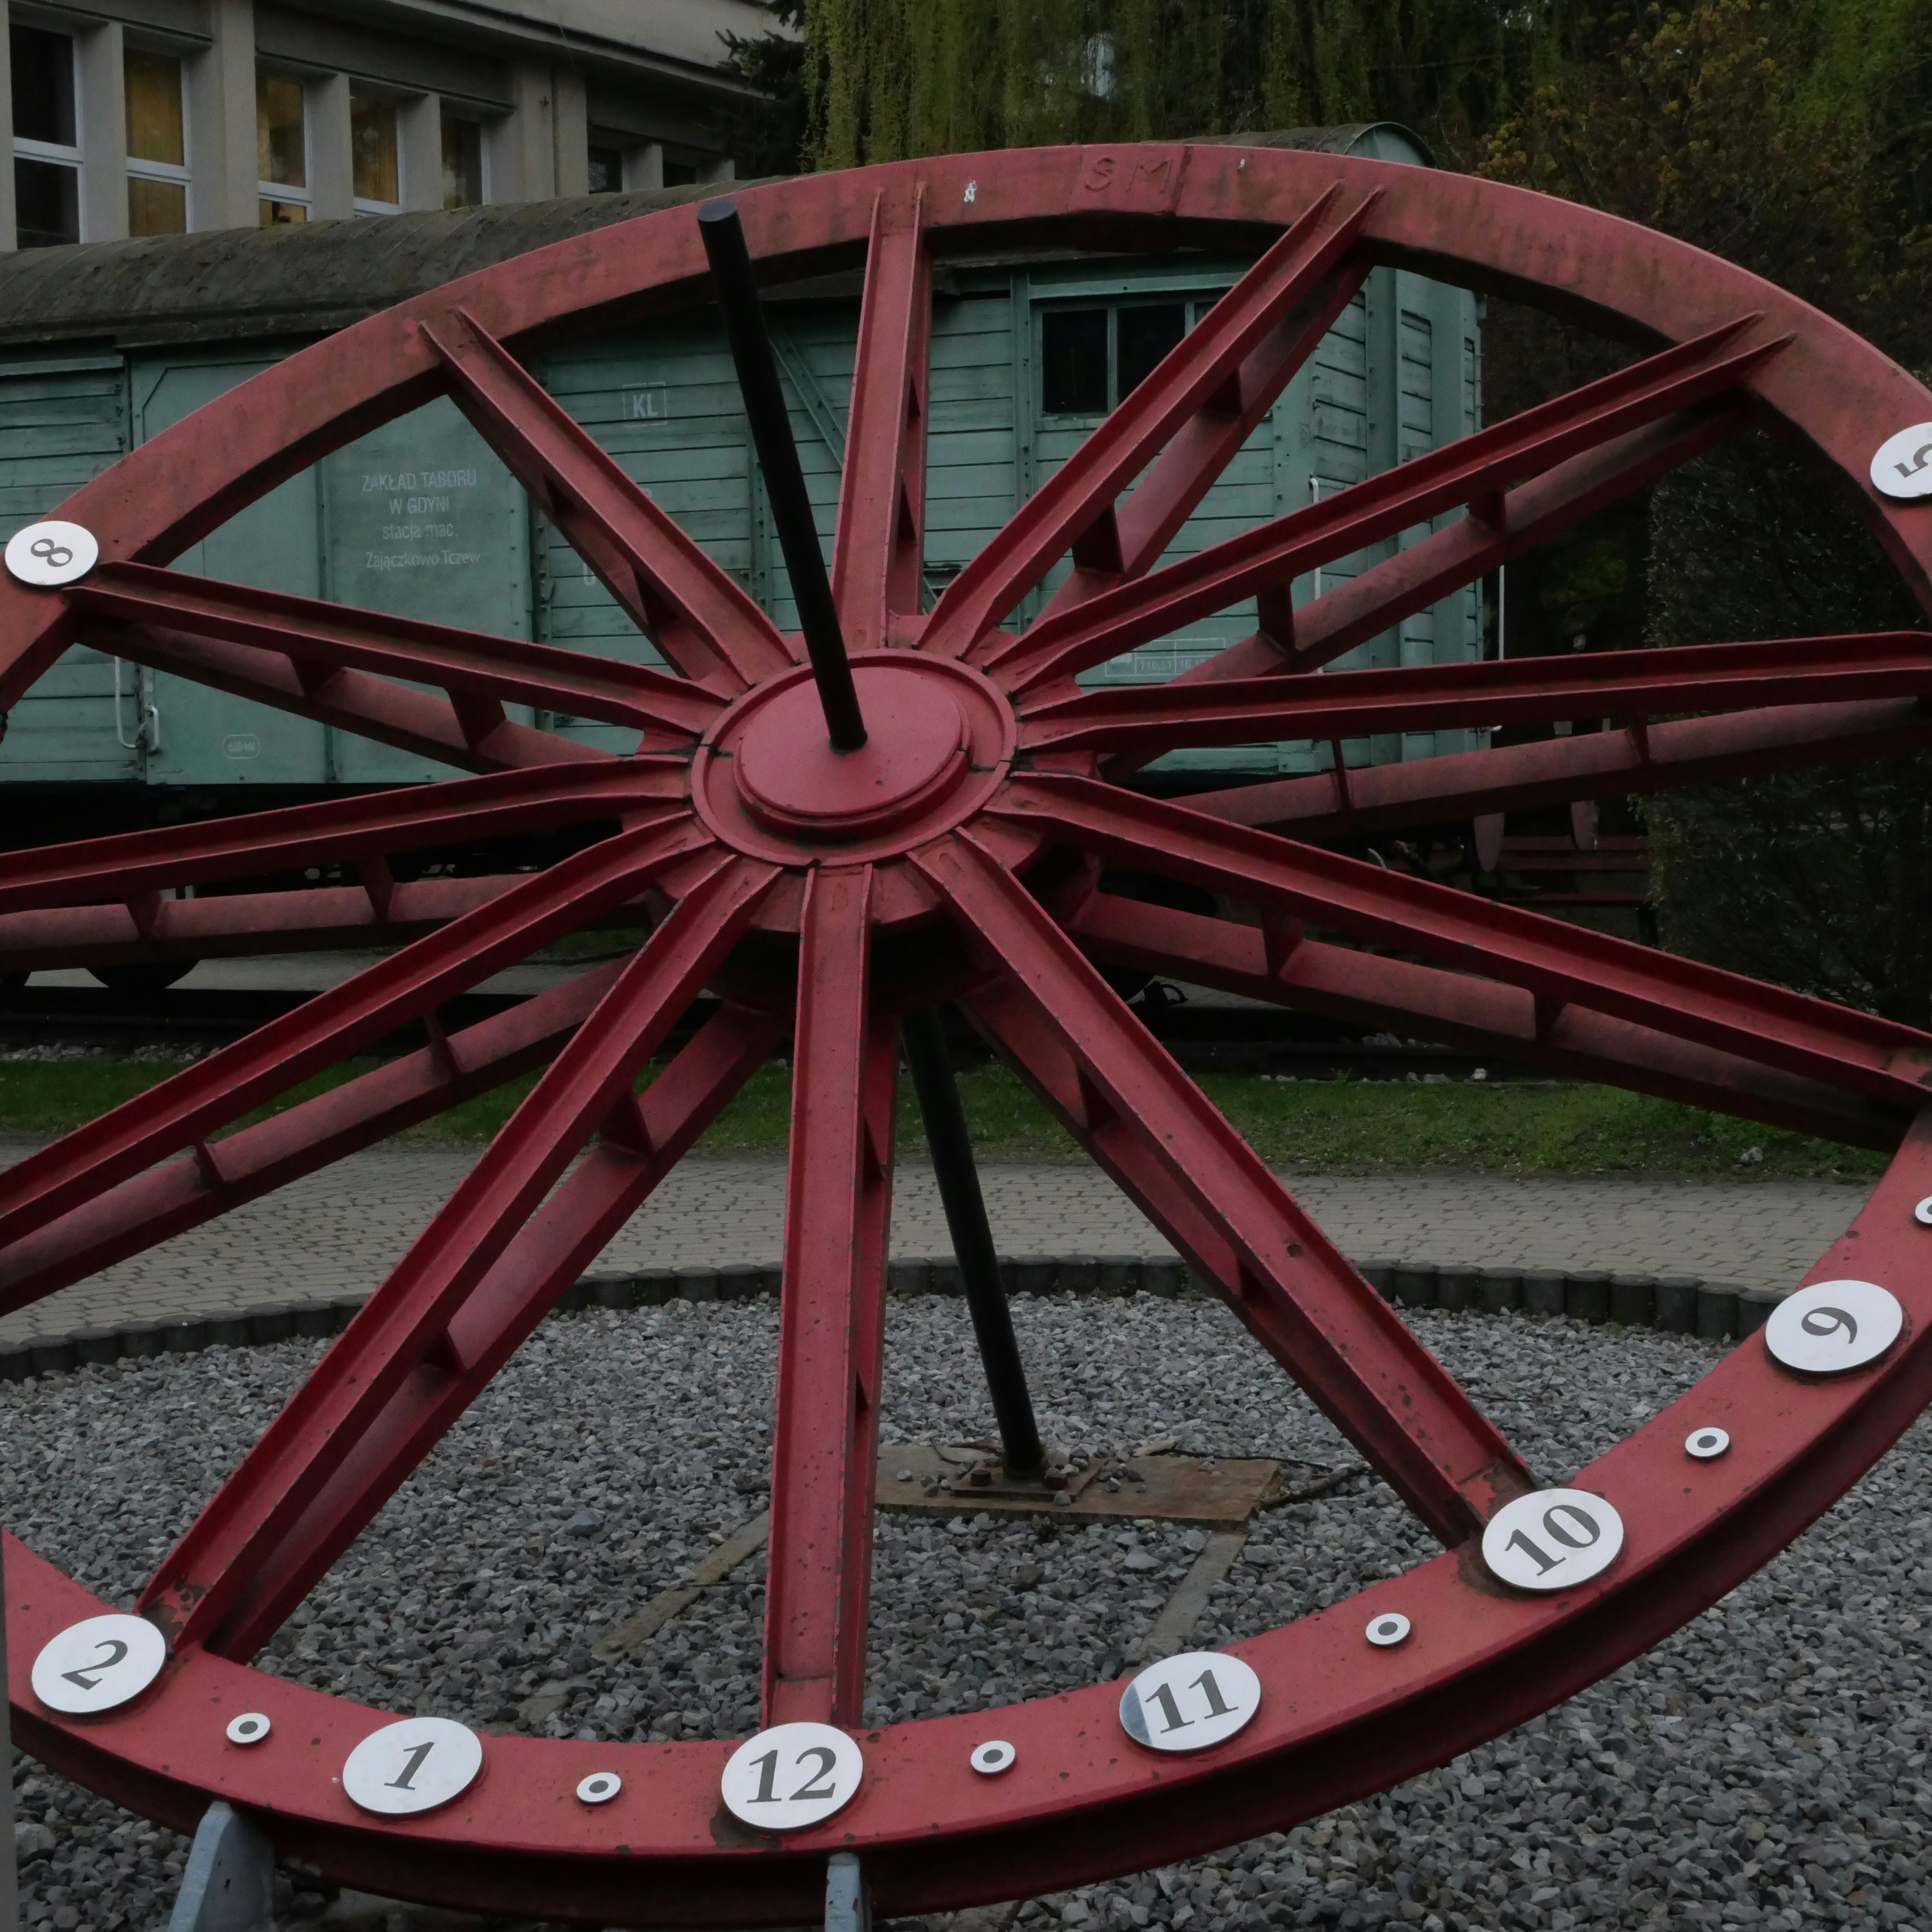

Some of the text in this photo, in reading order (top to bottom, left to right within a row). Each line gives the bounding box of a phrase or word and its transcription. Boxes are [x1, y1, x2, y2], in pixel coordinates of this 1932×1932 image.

[633, 393, 658, 417] KL
[1893, 443, 1932, 478] 5
[362, 469, 477, 492] ZAKŁAD TABORU
[390, 496, 449, 514] W GDYNI
[382, 523, 421, 542] stacja
[31, 539, 73, 567] 8
[366, 550, 481, 571] Zajączkowo Tczew
[1801, 1307, 1857, 1344] 9
[1505, 1505, 1600, 1576] 10
[61, 1640, 128, 1690] 2
[1144, 1669, 1239, 1734] 11
[384, 1742, 434, 1790] 1
[746, 1747, 836, 1803] 12
